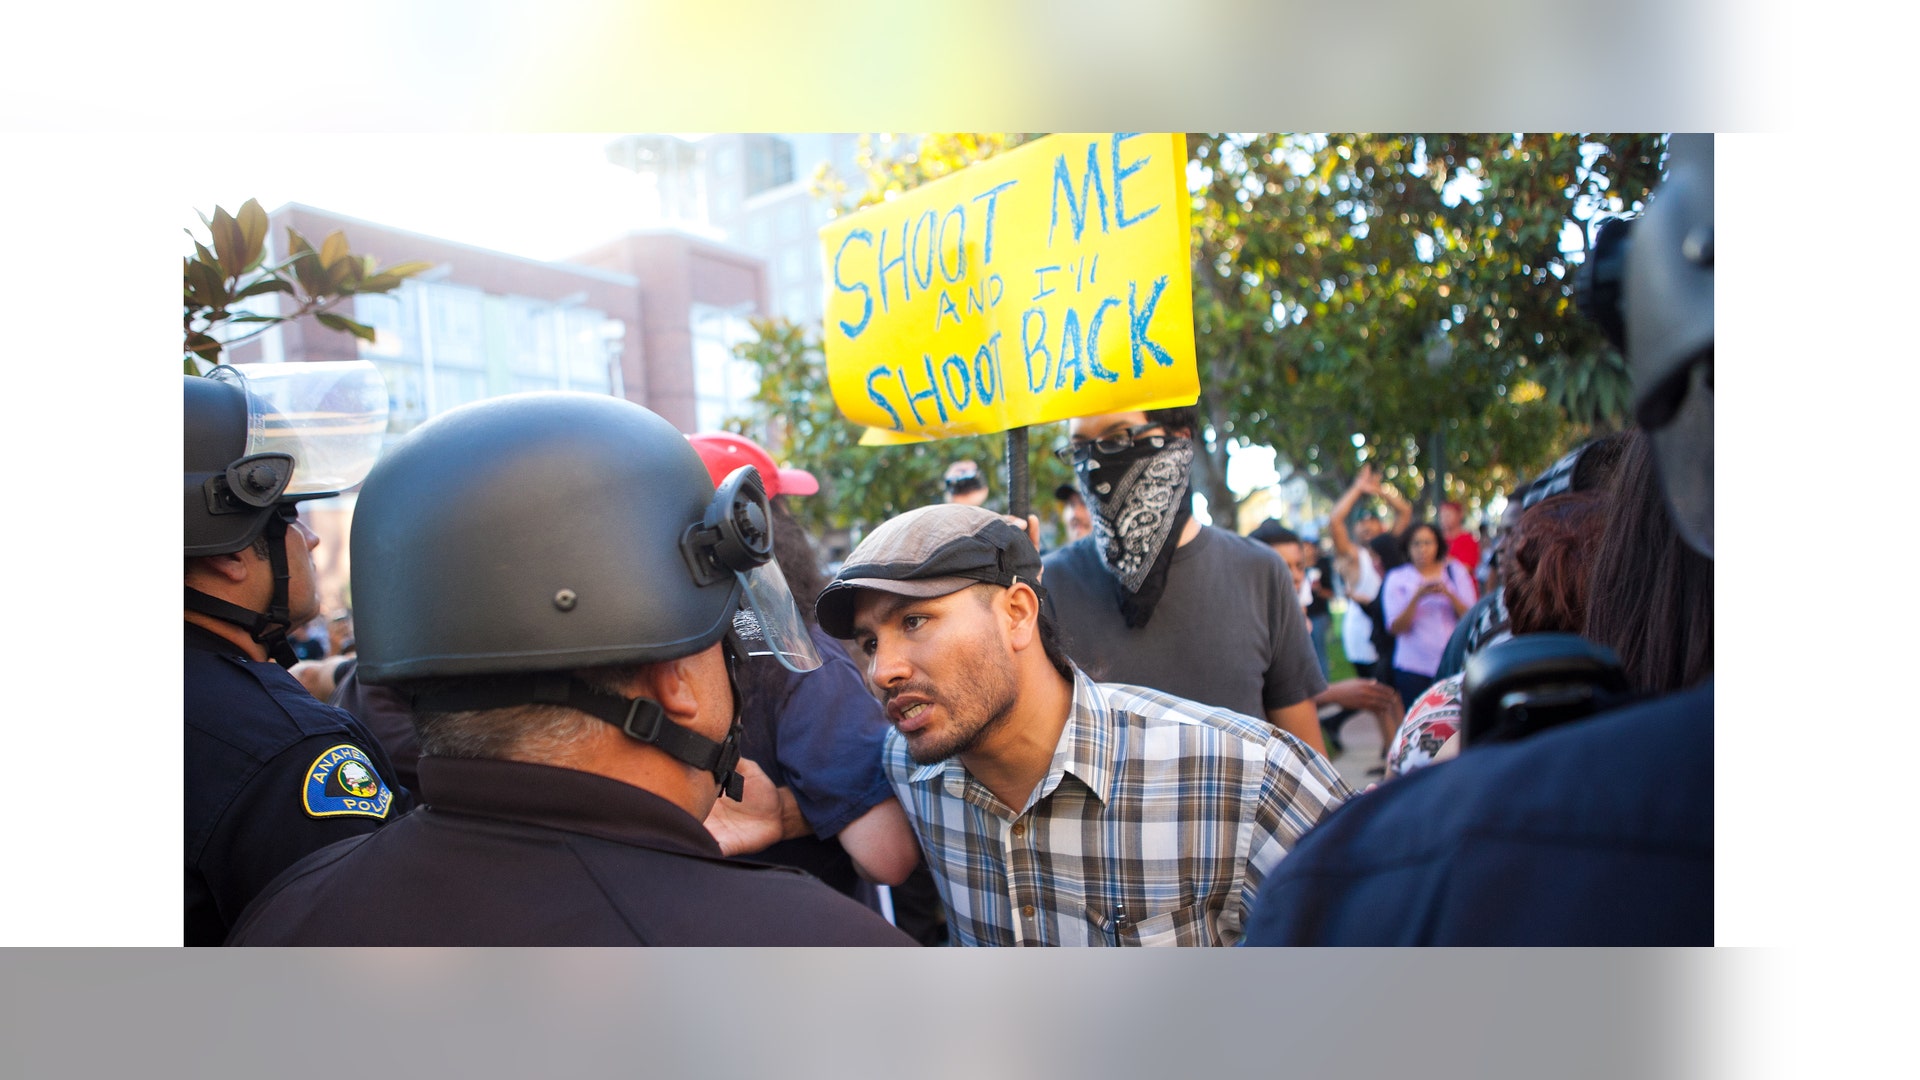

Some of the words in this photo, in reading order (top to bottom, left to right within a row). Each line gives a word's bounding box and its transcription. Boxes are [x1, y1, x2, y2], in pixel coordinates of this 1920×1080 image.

[834, 180, 1018, 339] SHOOT
[1048, 133, 1161, 248] ME
[866, 331, 1006, 432] SHOOT
[1022, 275, 1174, 394] BACK
[936, 274, 1004, 331] AND
[313, 749, 372, 784] ANAHE
